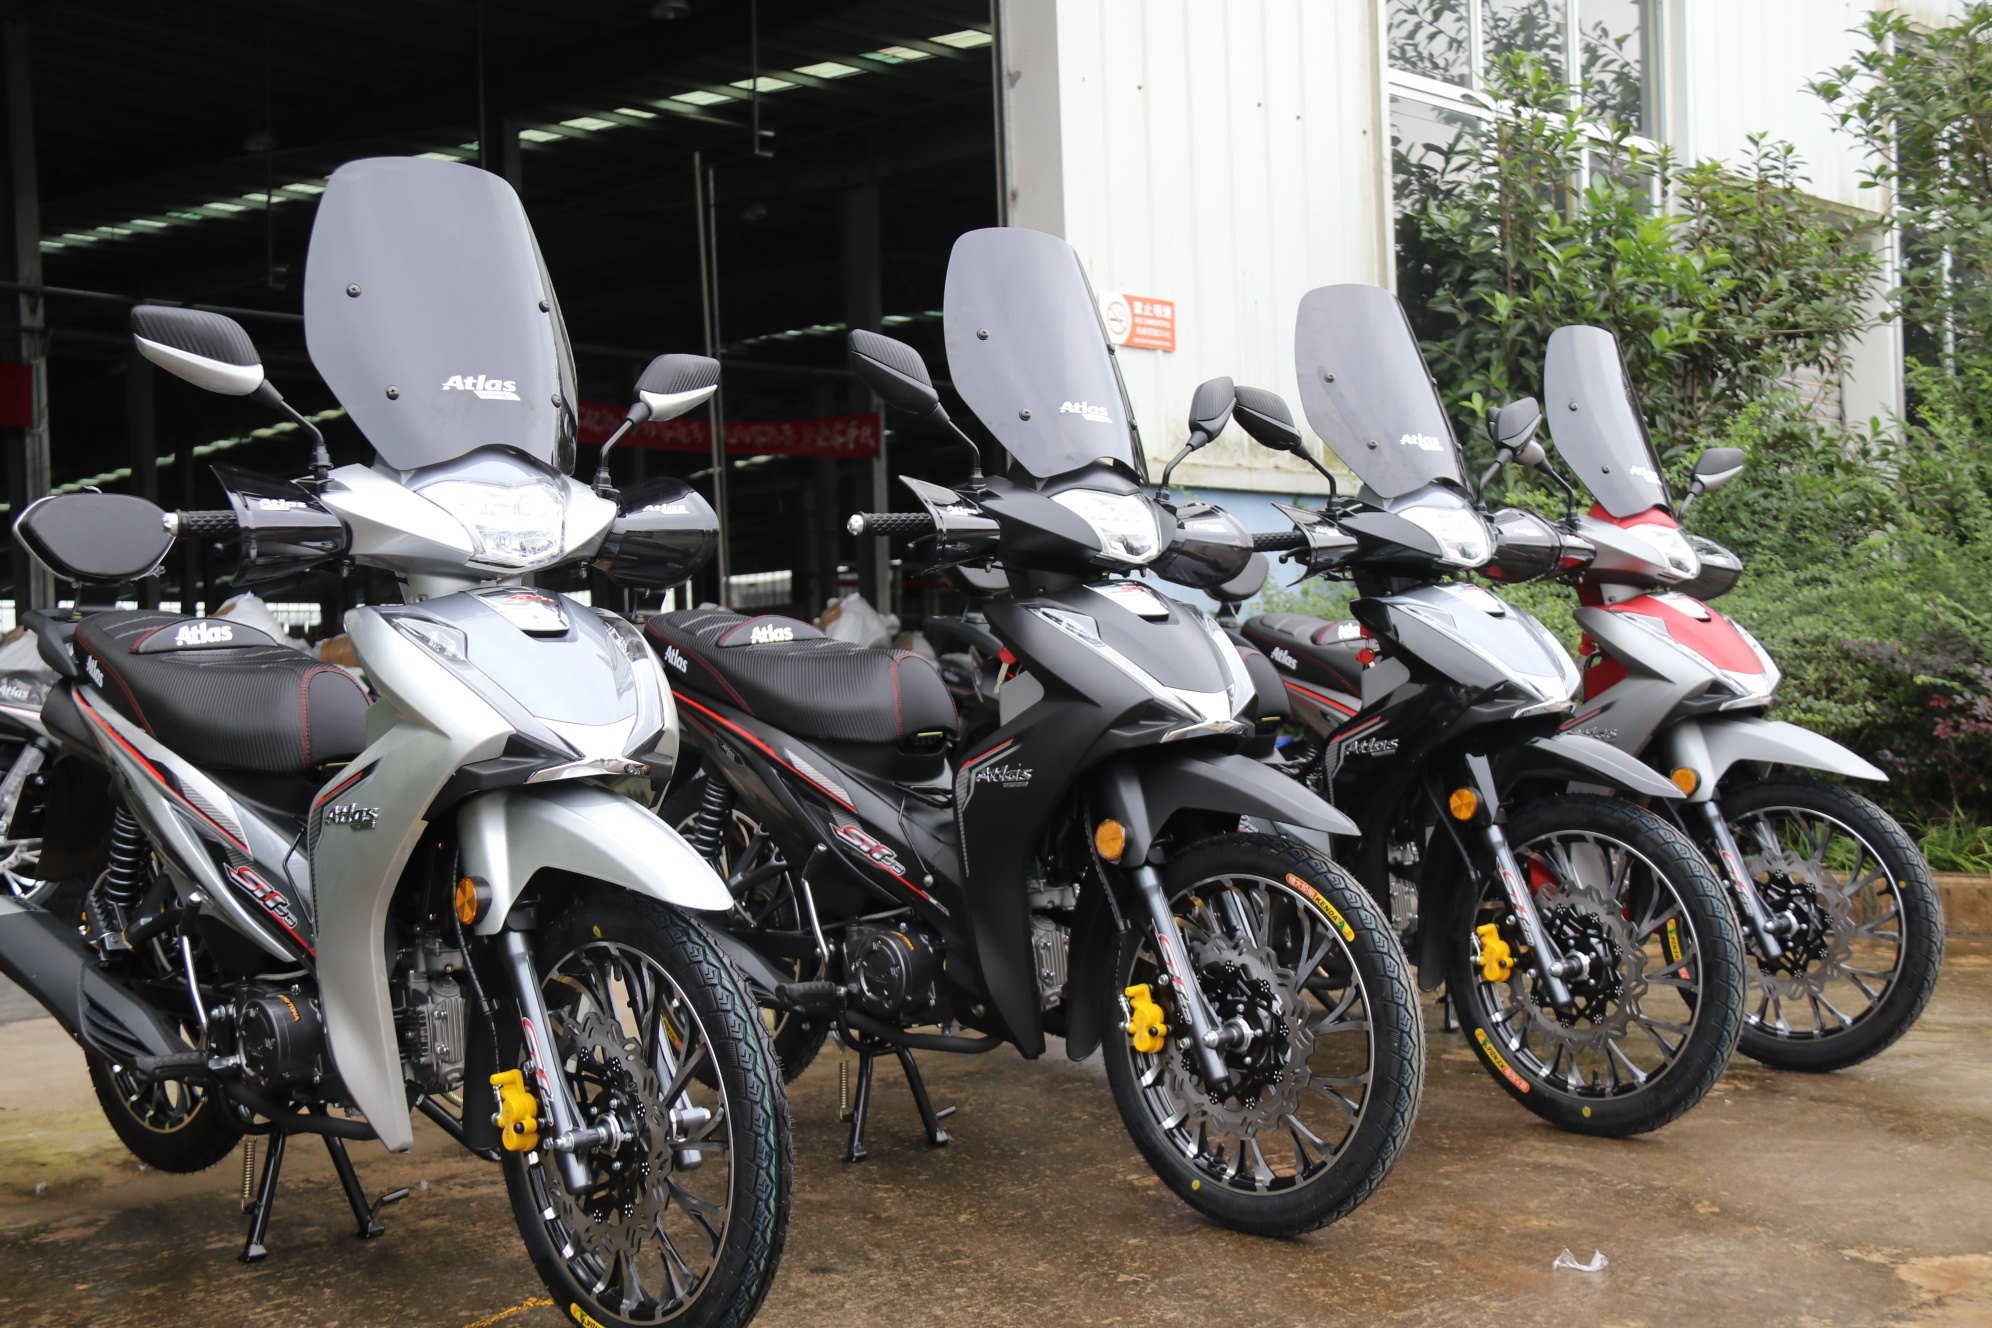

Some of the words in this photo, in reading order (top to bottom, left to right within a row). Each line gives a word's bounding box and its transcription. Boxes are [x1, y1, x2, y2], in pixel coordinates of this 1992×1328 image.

[441, 374, 517, 392] Atlas
[1059, 401, 1109, 416] Atlas
[175, 622, 233, 646] Atlas
[750, 624, 794, 645] Atlas
[664, 645, 689, 674] Atlas
[1270, 647, 1298, 670] Atlas
[86, 655, 105, 688] Atlas
[1345, 737, 1399, 754] Atlas
[976, 764, 1034, 782] Atlas
[323, 803, 379, 825] Atlas
[1315, 896, 1338, 921] KENDA
[1487, 1046, 1506, 1068] KENDA
